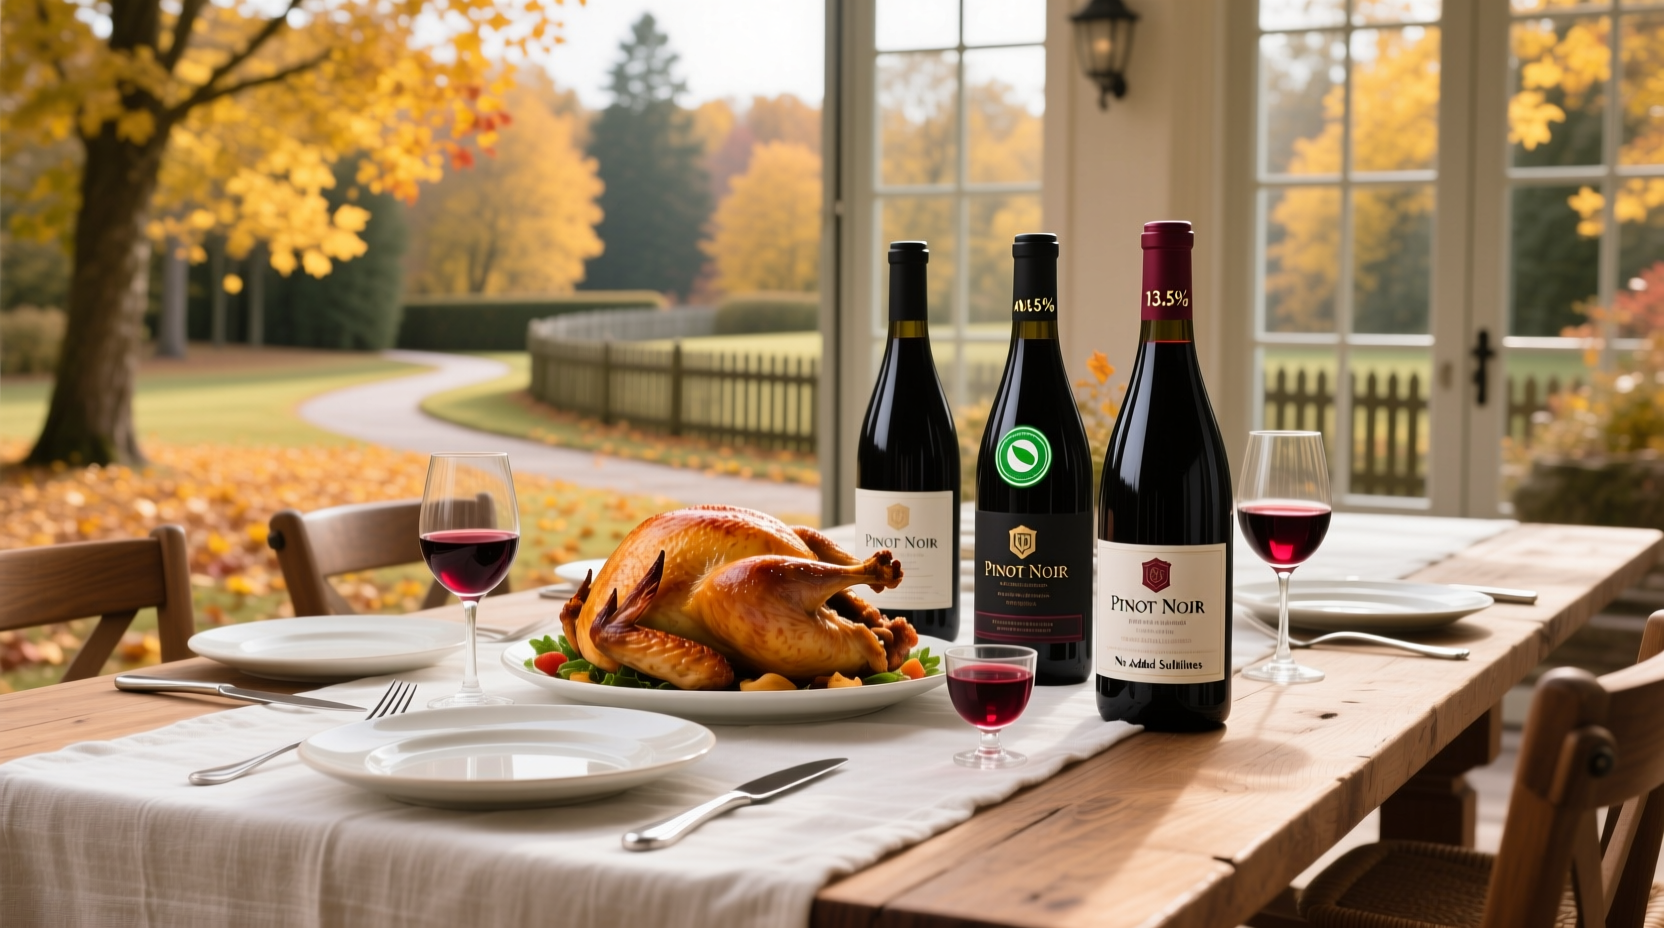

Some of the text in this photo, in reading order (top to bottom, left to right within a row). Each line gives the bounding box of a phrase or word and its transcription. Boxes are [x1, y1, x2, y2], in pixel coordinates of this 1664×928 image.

[1146, 289, 1189, 307] 13.5%
[865, 533, 938, 549] PINOT NOIR
[984, 560, 1069, 579] PINOT NOIR
[1111, 595, 1205, 614] PINOT NOIR
